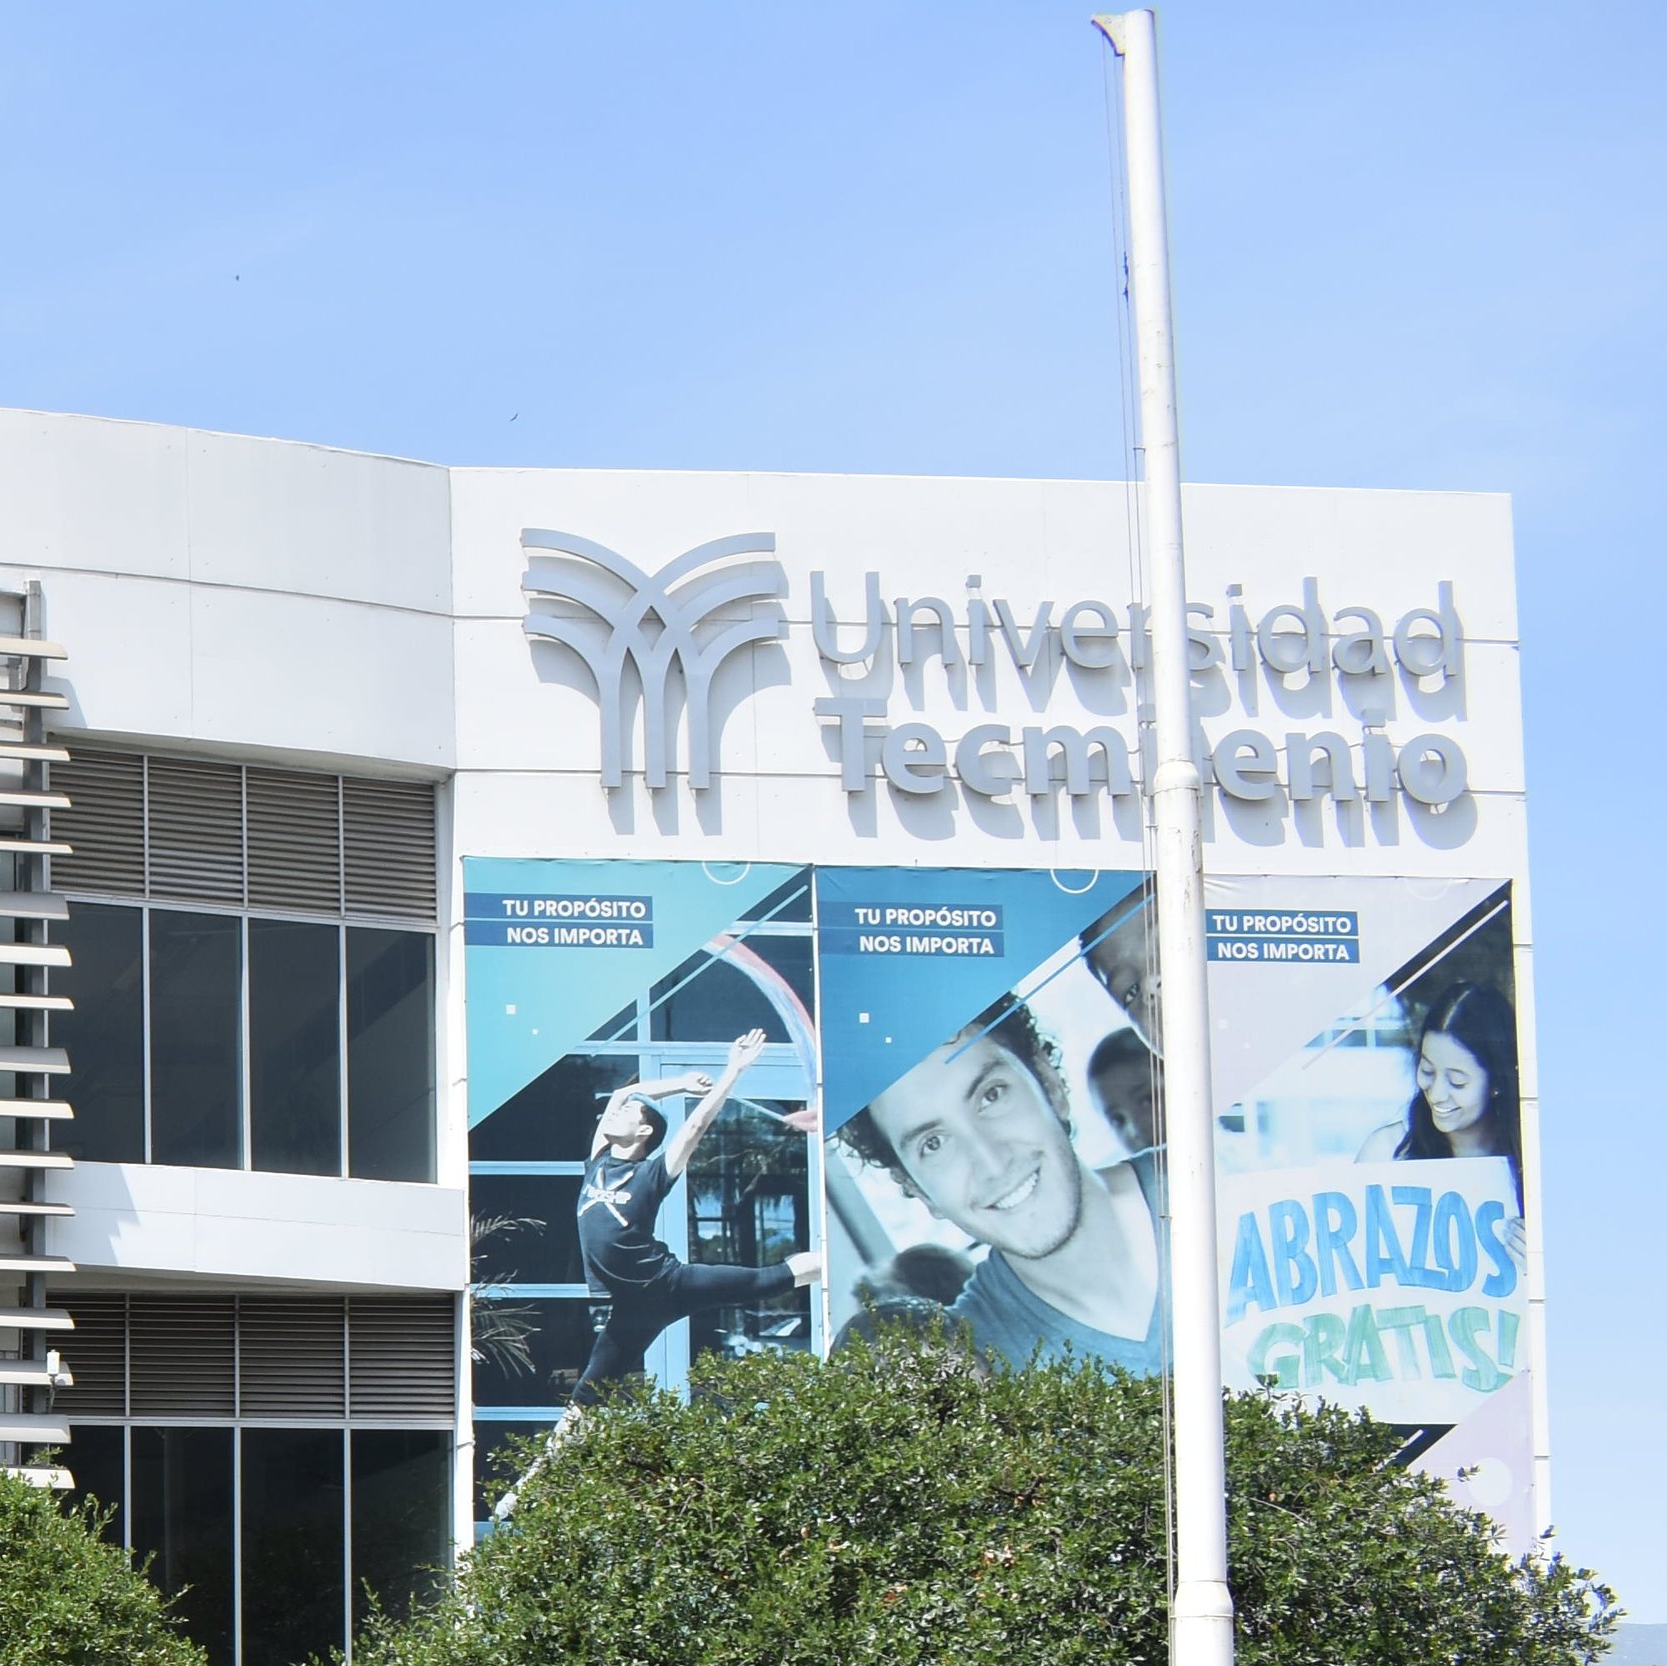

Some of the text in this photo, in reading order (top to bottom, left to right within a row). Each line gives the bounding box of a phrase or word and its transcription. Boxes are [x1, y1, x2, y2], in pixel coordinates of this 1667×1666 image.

[810, 571, 1459, 678] Universidad
[502, 898, 646, 919] TU PROPÓSITO
[854, 906, 997, 928] TU PROPÓSITO
[1212, 913, 1352, 934] TU PROPÓSITO
[507, 927, 644, 946] NOS IMPORTA
[859, 935, 995, 954] NOS IMPORTA
[1218, 942, 1350, 961] NOS IMPORTA
[1224, 1184, 1517, 1328] ABRAZOS
[1247, 1304, 1520, 1393] GRATIS!
